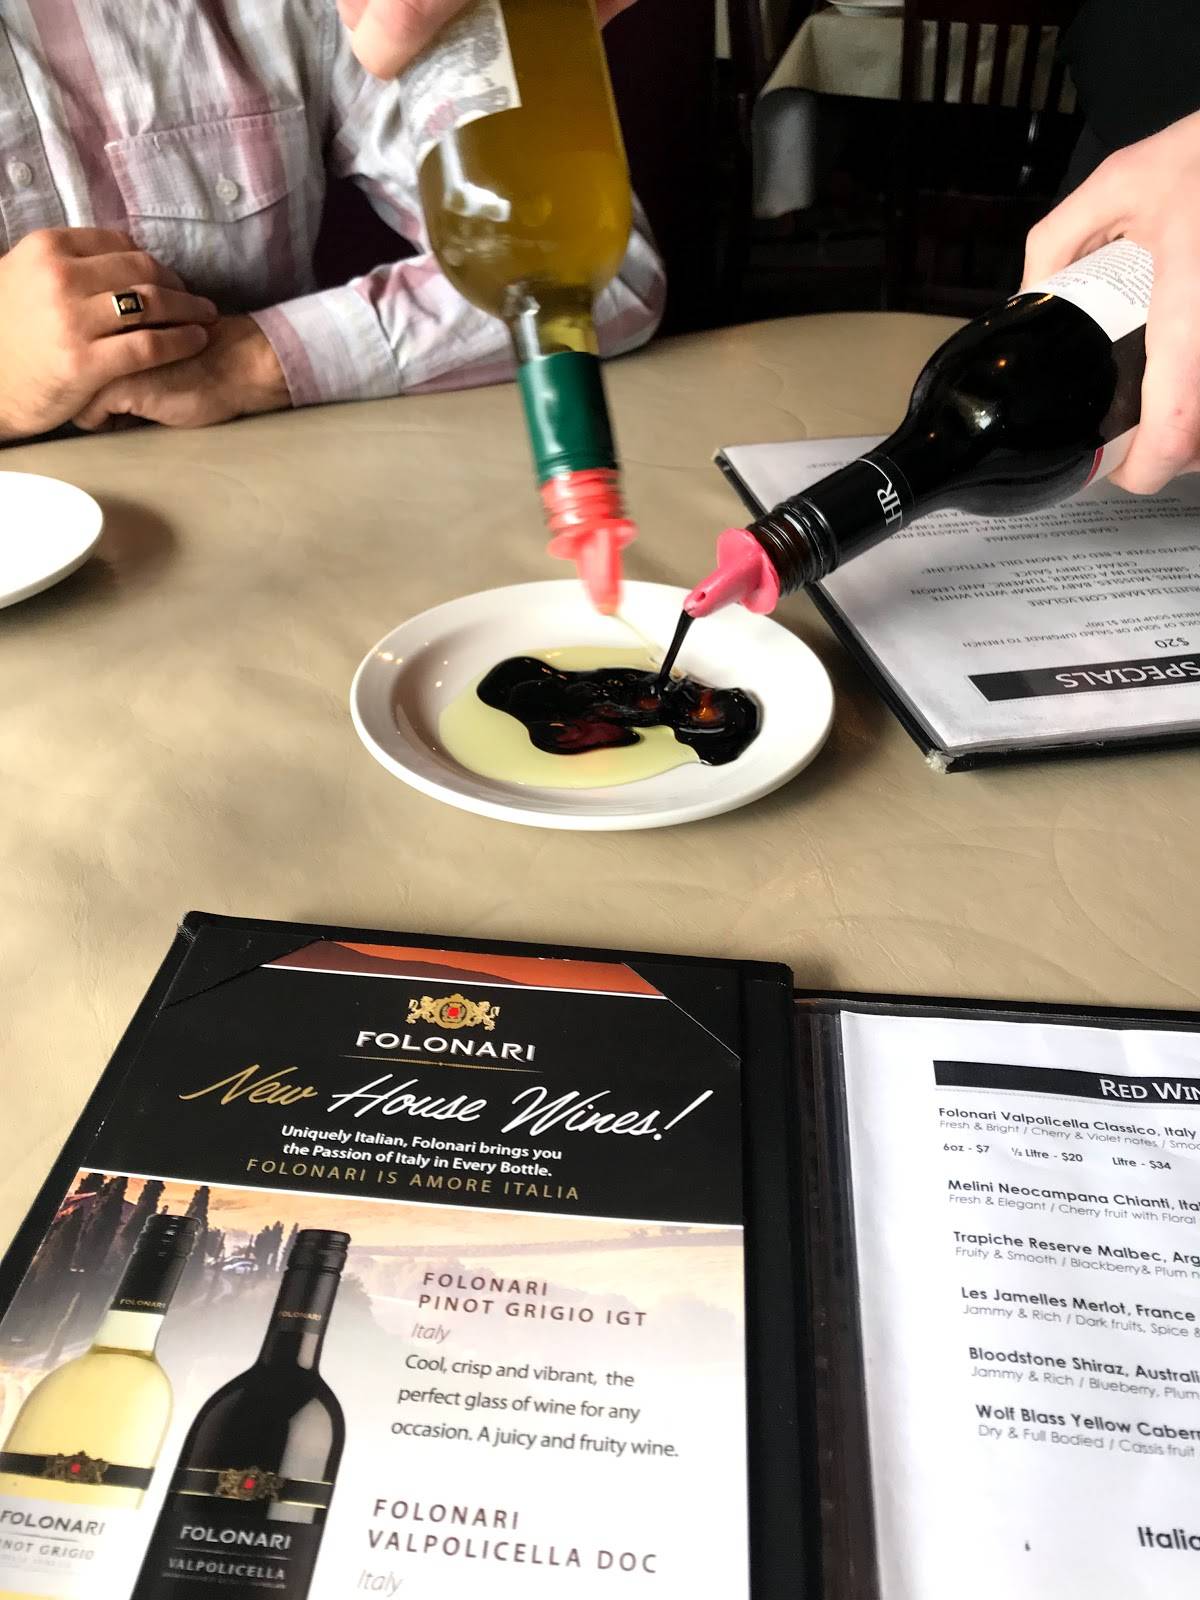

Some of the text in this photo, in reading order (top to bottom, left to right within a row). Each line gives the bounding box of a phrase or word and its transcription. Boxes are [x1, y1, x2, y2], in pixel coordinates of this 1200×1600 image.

[1154, 637, 1190, 649] $20
[1055, 662, 1200, 689] SPECIALS
[356, 1030, 536, 1063] FOLONARI
[179, 1064, 713, 1140] New House Wines!
[1100, 1079, 1148, 1099] RED
[939, 1108, 1196, 1140] Folonari Valpolicella Classico, Italy
[940, 1121, 970, 1129] Fresh
[974, 1122, 982, 1130] &
[986, 1123, 1019, 1134] Bright
[1031, 1127, 1070, 1139] Cherry
[1075, 1131, 1083, 1139] &
[1087, 1133, 1120, 1142] Violet
[1124, 1136, 1158, 1147] notes
[281, 1125, 562, 1160] Uniquely Italian, Folonari brings you
[943, 1143, 965, 1152] 6oz
[976, 1144, 990, 1154] $7
[1025, 1149, 1049, 1159] Litre
[1061, 1152, 1083, 1162] $20
[1112, 1157, 1137, 1167] Litre
[1149, 1160, 1172, 1170] $34
[283, 1142, 552, 1177] the Passion of Italy in Every Bottle.
[247, 1159, 579, 1200] FOLONARI IS AMORE ITALIA
[948, 1180, 994, 1192] Melini
[999, 1183, 1109, 1203] Neocampana
[1113, 1194, 1175, 1210] Chianti,
[949, 1194, 1196, 1224] Fresh & Elegant Cherry fruit with Floral
[953, 1231, 1024, 1247] Trapiche
[1028, 1237, 1092, 1254] Reserve
[1098, 1245, 1167, 1263] Malbec,
[956, 1247, 989, 1259] Fruity
[994, 1250, 1002, 1259] &
[1008, 1250, 1057, 1264] Smooth
[1155, 1266, 1188, 1278] Plum
[422, 1272, 548, 1296] FOLONARI
[418, 1294, 647, 1326] PINOT GRIGIO IGT
[961, 1287, 1196, 1322] Les Jamelles Merlot, France
[411, 1323, 450, 1343] Italy
[963, 1304, 1013, 1319] Jammy
[1018, 1308, 1027, 1318] &
[1032, 1309, 1061, 1322] Rich
[1076, 1314, 1107, 1328] Dark
[1151, 1323, 1189, 1336] Spice
[405, 1354, 635, 1387] Cool, crisp and vibrant, the
[969, 1347, 1066, 1368] Bloodstone
[1072, 1357, 1129, 1377] Shiraz,
[971, 1366, 1023, 1382] Jammy
[1029, 1371, 1038, 1382] &
[1043, 1372, 1074, 1386] Rich
[397, 1387, 640, 1423] perfect glass of wine for any
[976, 1404, 1014, 1420] Wolf
[1020, 1408, 1066, 1426] Blass
[1071, 1413, 1131, 1433] Yellow
[391, 1421, 679, 1457] occasion. A juicy and fruity wine.
[978, 1424, 1194, 1457] Dry & Full Bodied Cassis fruit
[0, 1509, 106, 1536] FOLONARI
[373, 1498, 519, 1530] FOLONARI
[40, 1545, 95, 1560] GRIGIO
[180, 1525, 291, 1550] FOLONARI
[368, 1529, 657, 1574] VALPOLICELLA DOC
[167, 1557, 286, 1581] VALPOLICELLA
[357, 1569, 402, 1597] Italy
